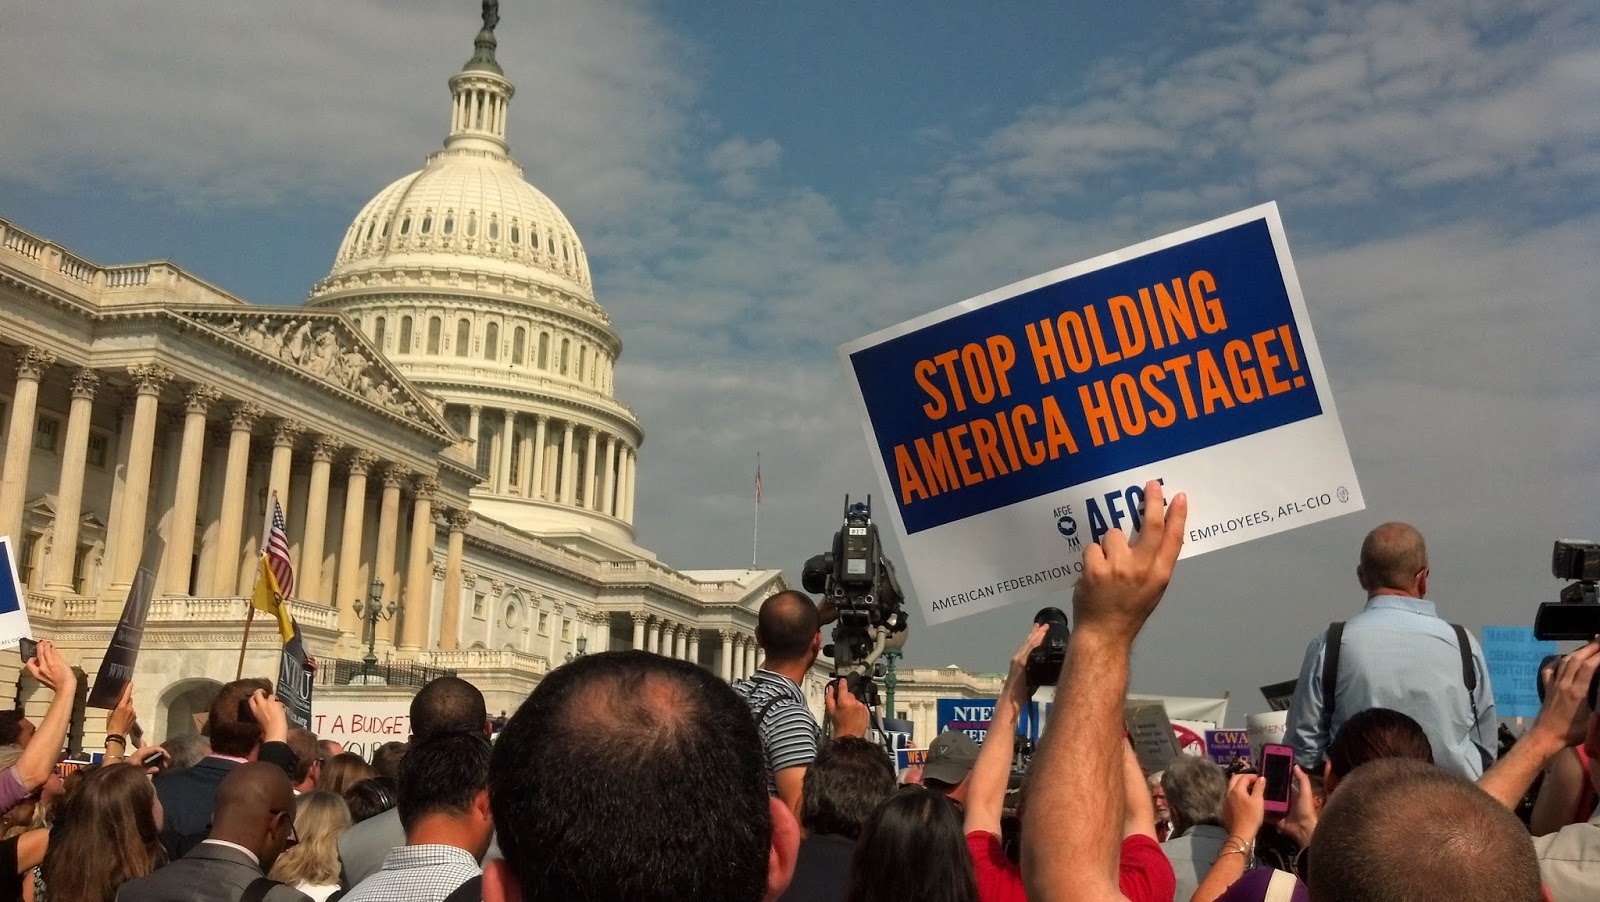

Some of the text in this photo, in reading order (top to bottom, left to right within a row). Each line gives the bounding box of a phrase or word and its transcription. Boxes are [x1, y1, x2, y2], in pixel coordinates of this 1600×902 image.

[915, 270, 1227, 420] STOP HOLDING
[894, 325, 1306, 504] AMERICA HOSTAGE!
[1053, 504, 1073, 518] AFGE
[1085, 478, 1167, 546] AFG
[1189, 510, 1275, 542] EMPLOYEES,
[1278, 493, 1331, 518] AFL-CIO
[932, 585, 995, 612] AMERICAN
[996, 564, 1072, 594] FEDERATION
[331, 715, 344, 734] A
[953, 706, 996, 722] NTE
[1214, 731, 1249, 744] CWA
